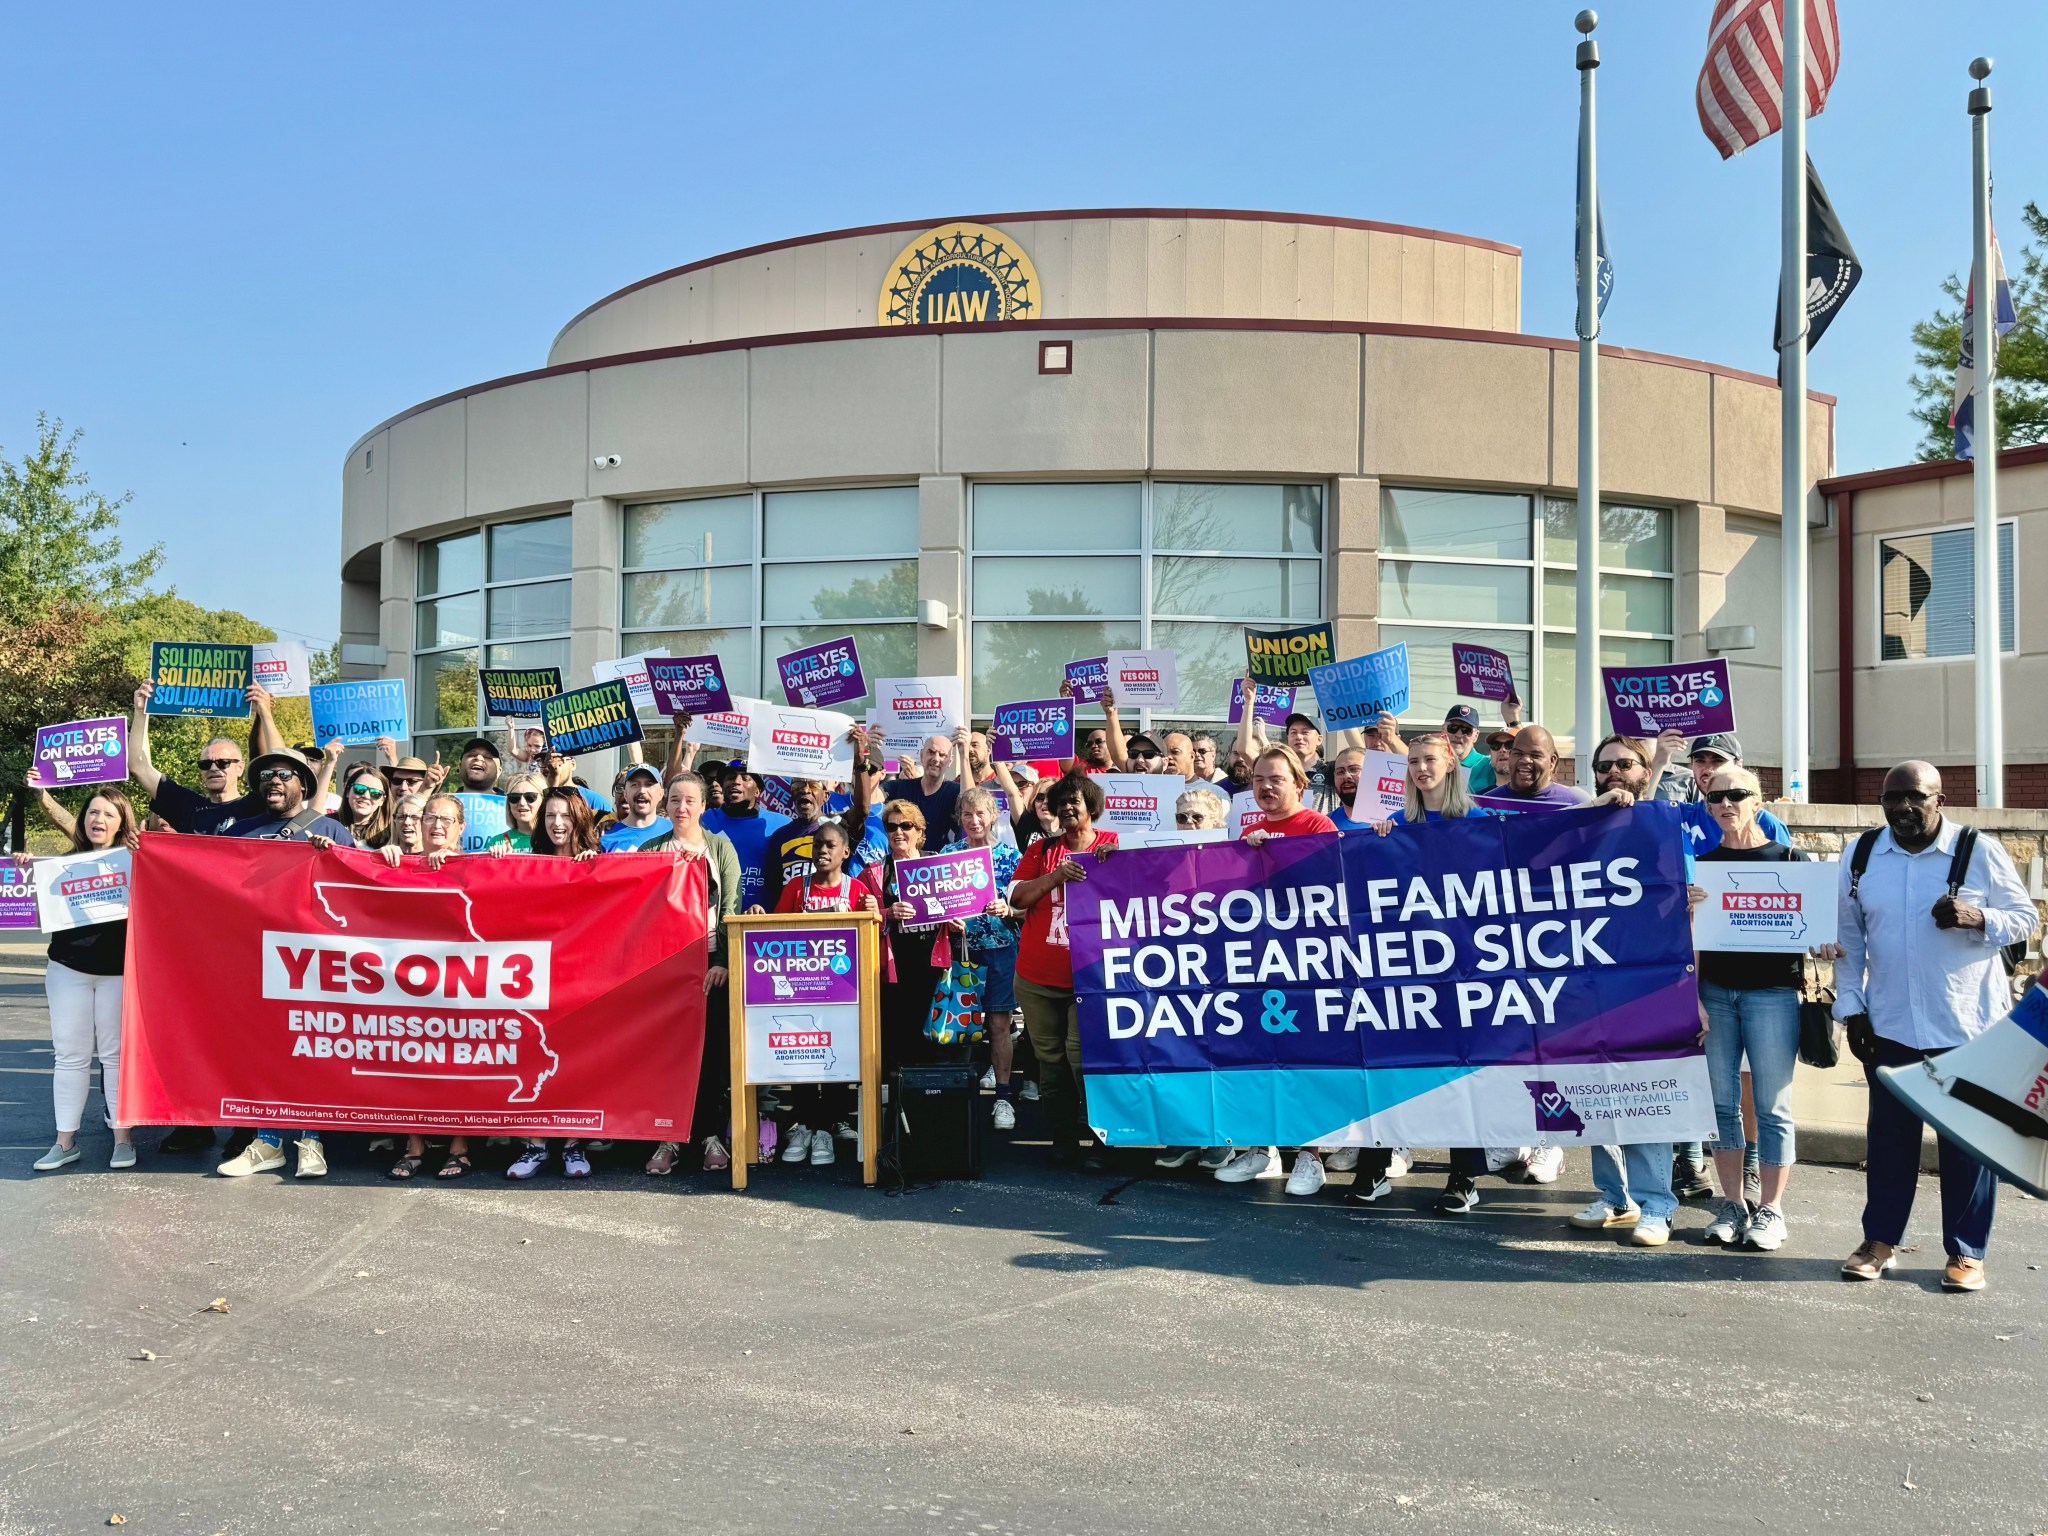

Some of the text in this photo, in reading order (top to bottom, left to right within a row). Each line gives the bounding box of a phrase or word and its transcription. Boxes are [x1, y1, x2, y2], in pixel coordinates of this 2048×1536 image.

[930, 259, 941, 268] AND
[942, 252, 983, 262] AGRICULTURE
[983, 259, 1007, 285] IMPLEMENT
[928, 290, 990, 324] UAW
[1247, 631, 1328, 655] UNION
[159, 647, 247, 669] SOLIDARITY
[263, 662, 277, 671] ON
[279, 662, 285, 671] 3
[783, 647, 850, 676] VOTE YES
[1249, 649, 1331, 676] STRONG
[1314, 648, 1403, 685] SOLIDARITY
[1458, 650, 1508, 671] VOTE YES
[157, 667, 246, 689] SOLIDARITY
[485, 671, 555, 686] SOLIDARITY
[634, 674, 648, 682] ON
[650, 663, 715, 679] VOTE YES
[787, 662, 853, 688] ON PROP A
[1069, 664, 1101, 677] VOTE
[1070, 673, 1108, 686] ON PRO
[1122, 672, 1157, 680] YES ON 3
[1459, 664, 1504, 678] ON PROP
[655, 680, 671, 691] ON
[673, 679, 704, 691] PROP
[708, 678, 719, 688] A
[1267, 685, 1290, 696] YES
[1318, 664, 1405, 699] SOLIDARITY
[1610, 670, 1717, 693] VOTE YES
[154, 686, 245, 708] SOLIDARITY
[314, 684, 400, 702] SOLIDARITY
[488, 684, 557, 699] SOLIDARITY
[1615, 689, 1719, 708] ON PROP A
[315, 697, 400, 714] SOLIDARITY
[491, 699, 541, 712] SOLIDAR
[546, 684, 623, 719] SOLIDARITY
[894, 699, 939, 708] YES ON 3
[1326, 687, 1407, 722] SOLIDARITY
[548, 701, 627, 736] SOLIDARITY
[706, 713, 725, 722] YES
[725, 715, 739, 723] ON
[999, 707, 1066, 724] VOTE YES
[43, 726, 118, 747] VOTE YES
[318, 719, 403, 738] SOLIDARITY
[551, 718, 633, 753] SOLIDARITY
[997, 721, 1066, 735] ON PROP A
[775, 732, 828, 746] YES ON 3
[40, 743, 117, 760] ON PROP A
[1381, 779, 1402, 792] YES
[1107, 798, 1155, 808] YES ON 3
[1243, 814, 1257, 823] YES
[904, 857, 984, 883] VOTE YES
[63, 875, 125, 893] YES ON 3
[906, 876, 972, 896] ON PROP
[70, 893, 122, 907] ABORTION BAN
[84, 888, 123, 900] MISSOURI'S
[1099, 857, 1644, 939] MISSOURI FAMILIES
[1726, 896, 1798, 909] YES ON 3
[753, 939, 847, 957] VOTE YES
[1103, 916, 1618, 989] FOR EARNED SICK
[275, 946, 534, 999] YES ON 3
[754, 958, 847, 972] ON PROP A
[1106, 976, 1568, 1039] DAYS & FAIR PAY
[288, 1010, 523, 1039] END MISSOURI'S
[771, 1034, 829, 1045] YES ON 3
[292, 1036, 518, 1065] ABORTION BAN
[1565, 1079, 1677, 1095] MISSOURIANS FOR
[1575, 1091, 1689, 1107] HEALTHY FAMILIES
[226, 1104, 600, 1124] "Paid for by Missourians for Constitutional Freedom, Michael Pridmore, Treasurer"
[1584, 1105, 1671, 1120] & FAIR WAGES
